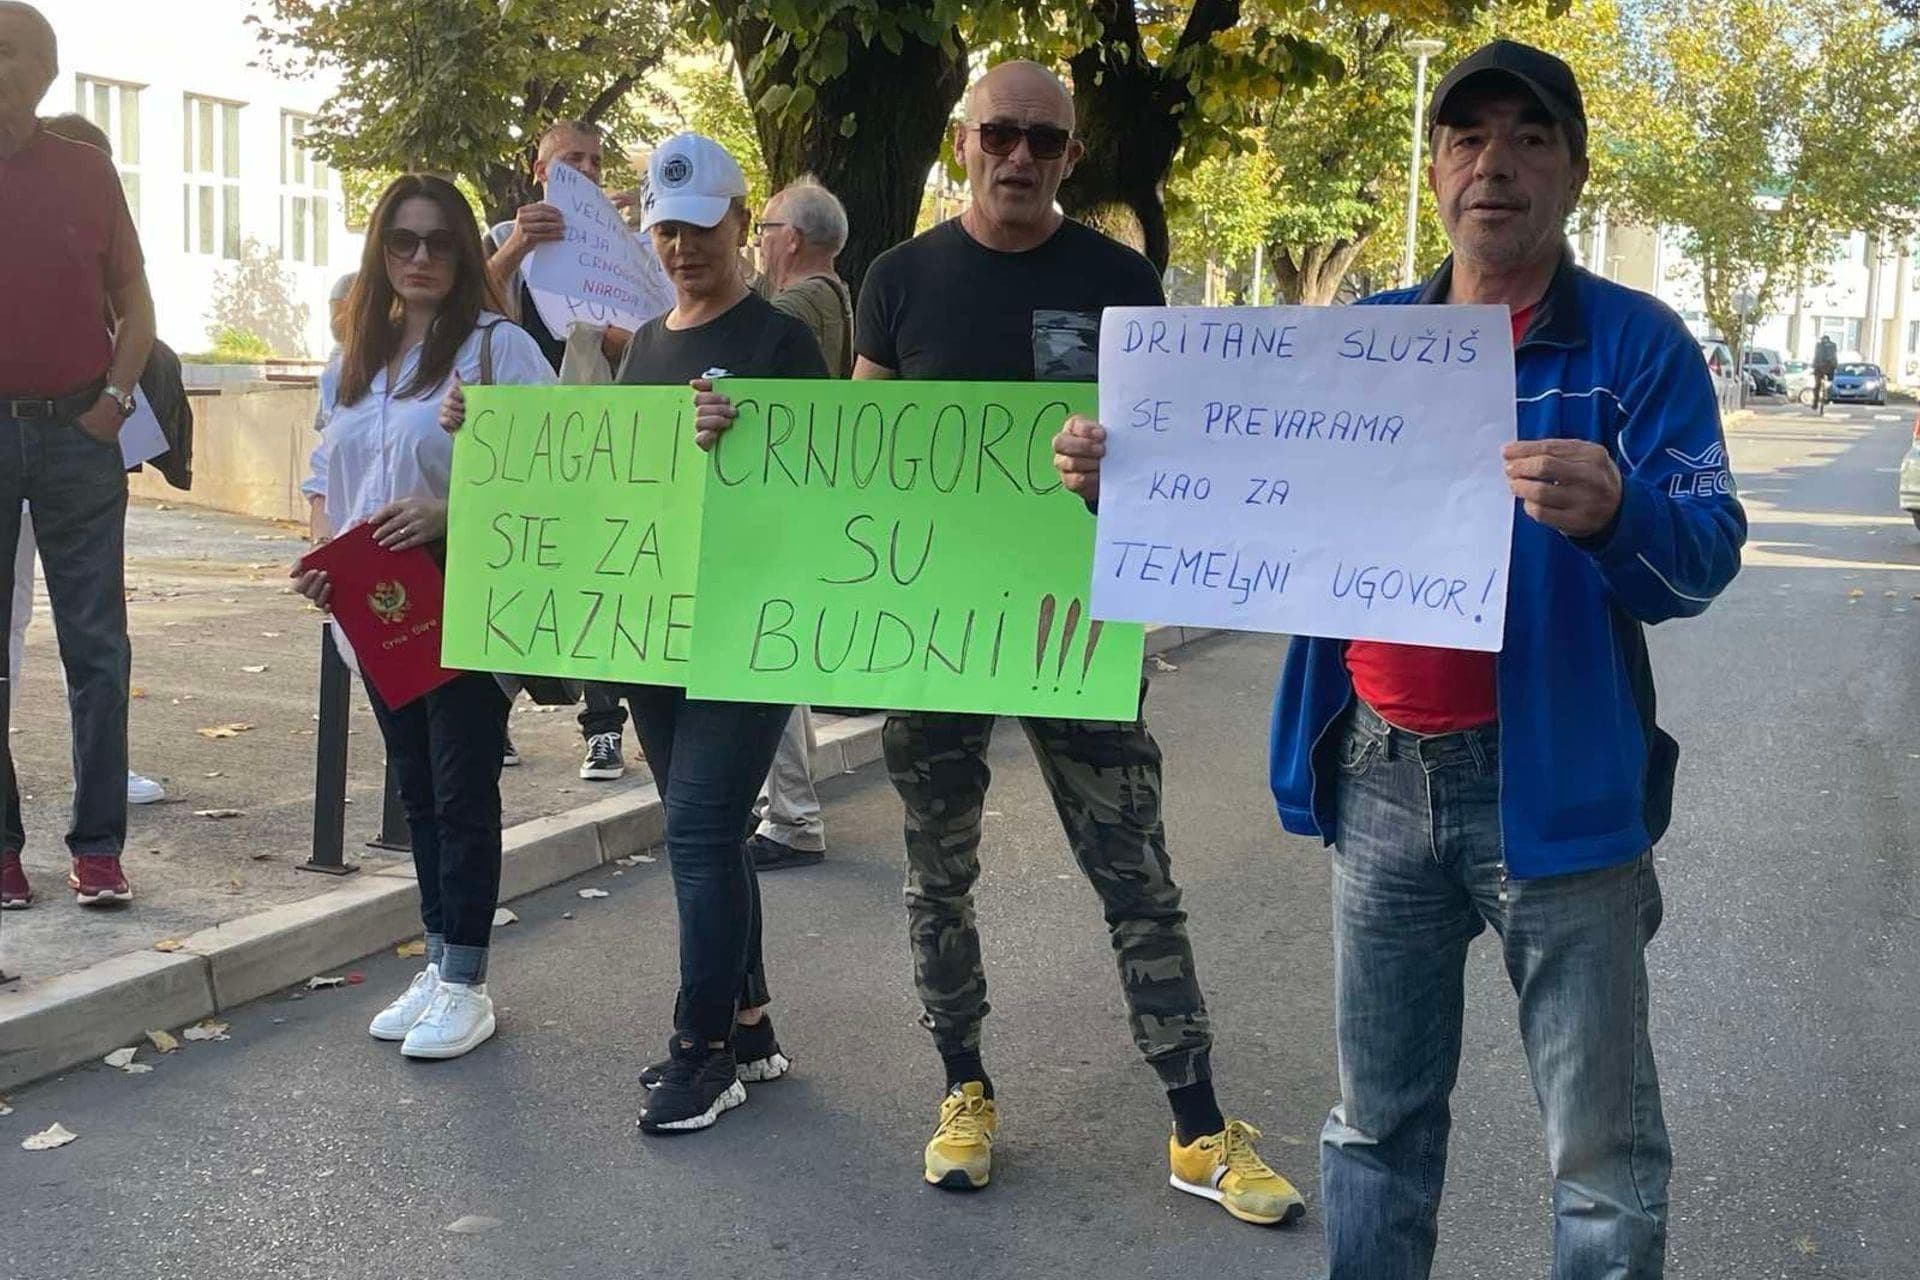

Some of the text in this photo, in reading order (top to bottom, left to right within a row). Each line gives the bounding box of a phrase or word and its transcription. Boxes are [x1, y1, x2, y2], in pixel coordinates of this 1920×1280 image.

[1121, 314, 1480, 365] DRITANE SLUŽIŠ
[470, 398, 684, 486] SLAGALI
[1131, 398, 1405, 444] SE PREVARAMA
[1148, 470, 1291, 505] KAO ZA
[486, 512, 663, 580] STE ZA
[816, 513, 935, 585] SU
[485, 587, 695, 662] KAZNE
[1332, 561, 1498, 623] UGOVOR!
